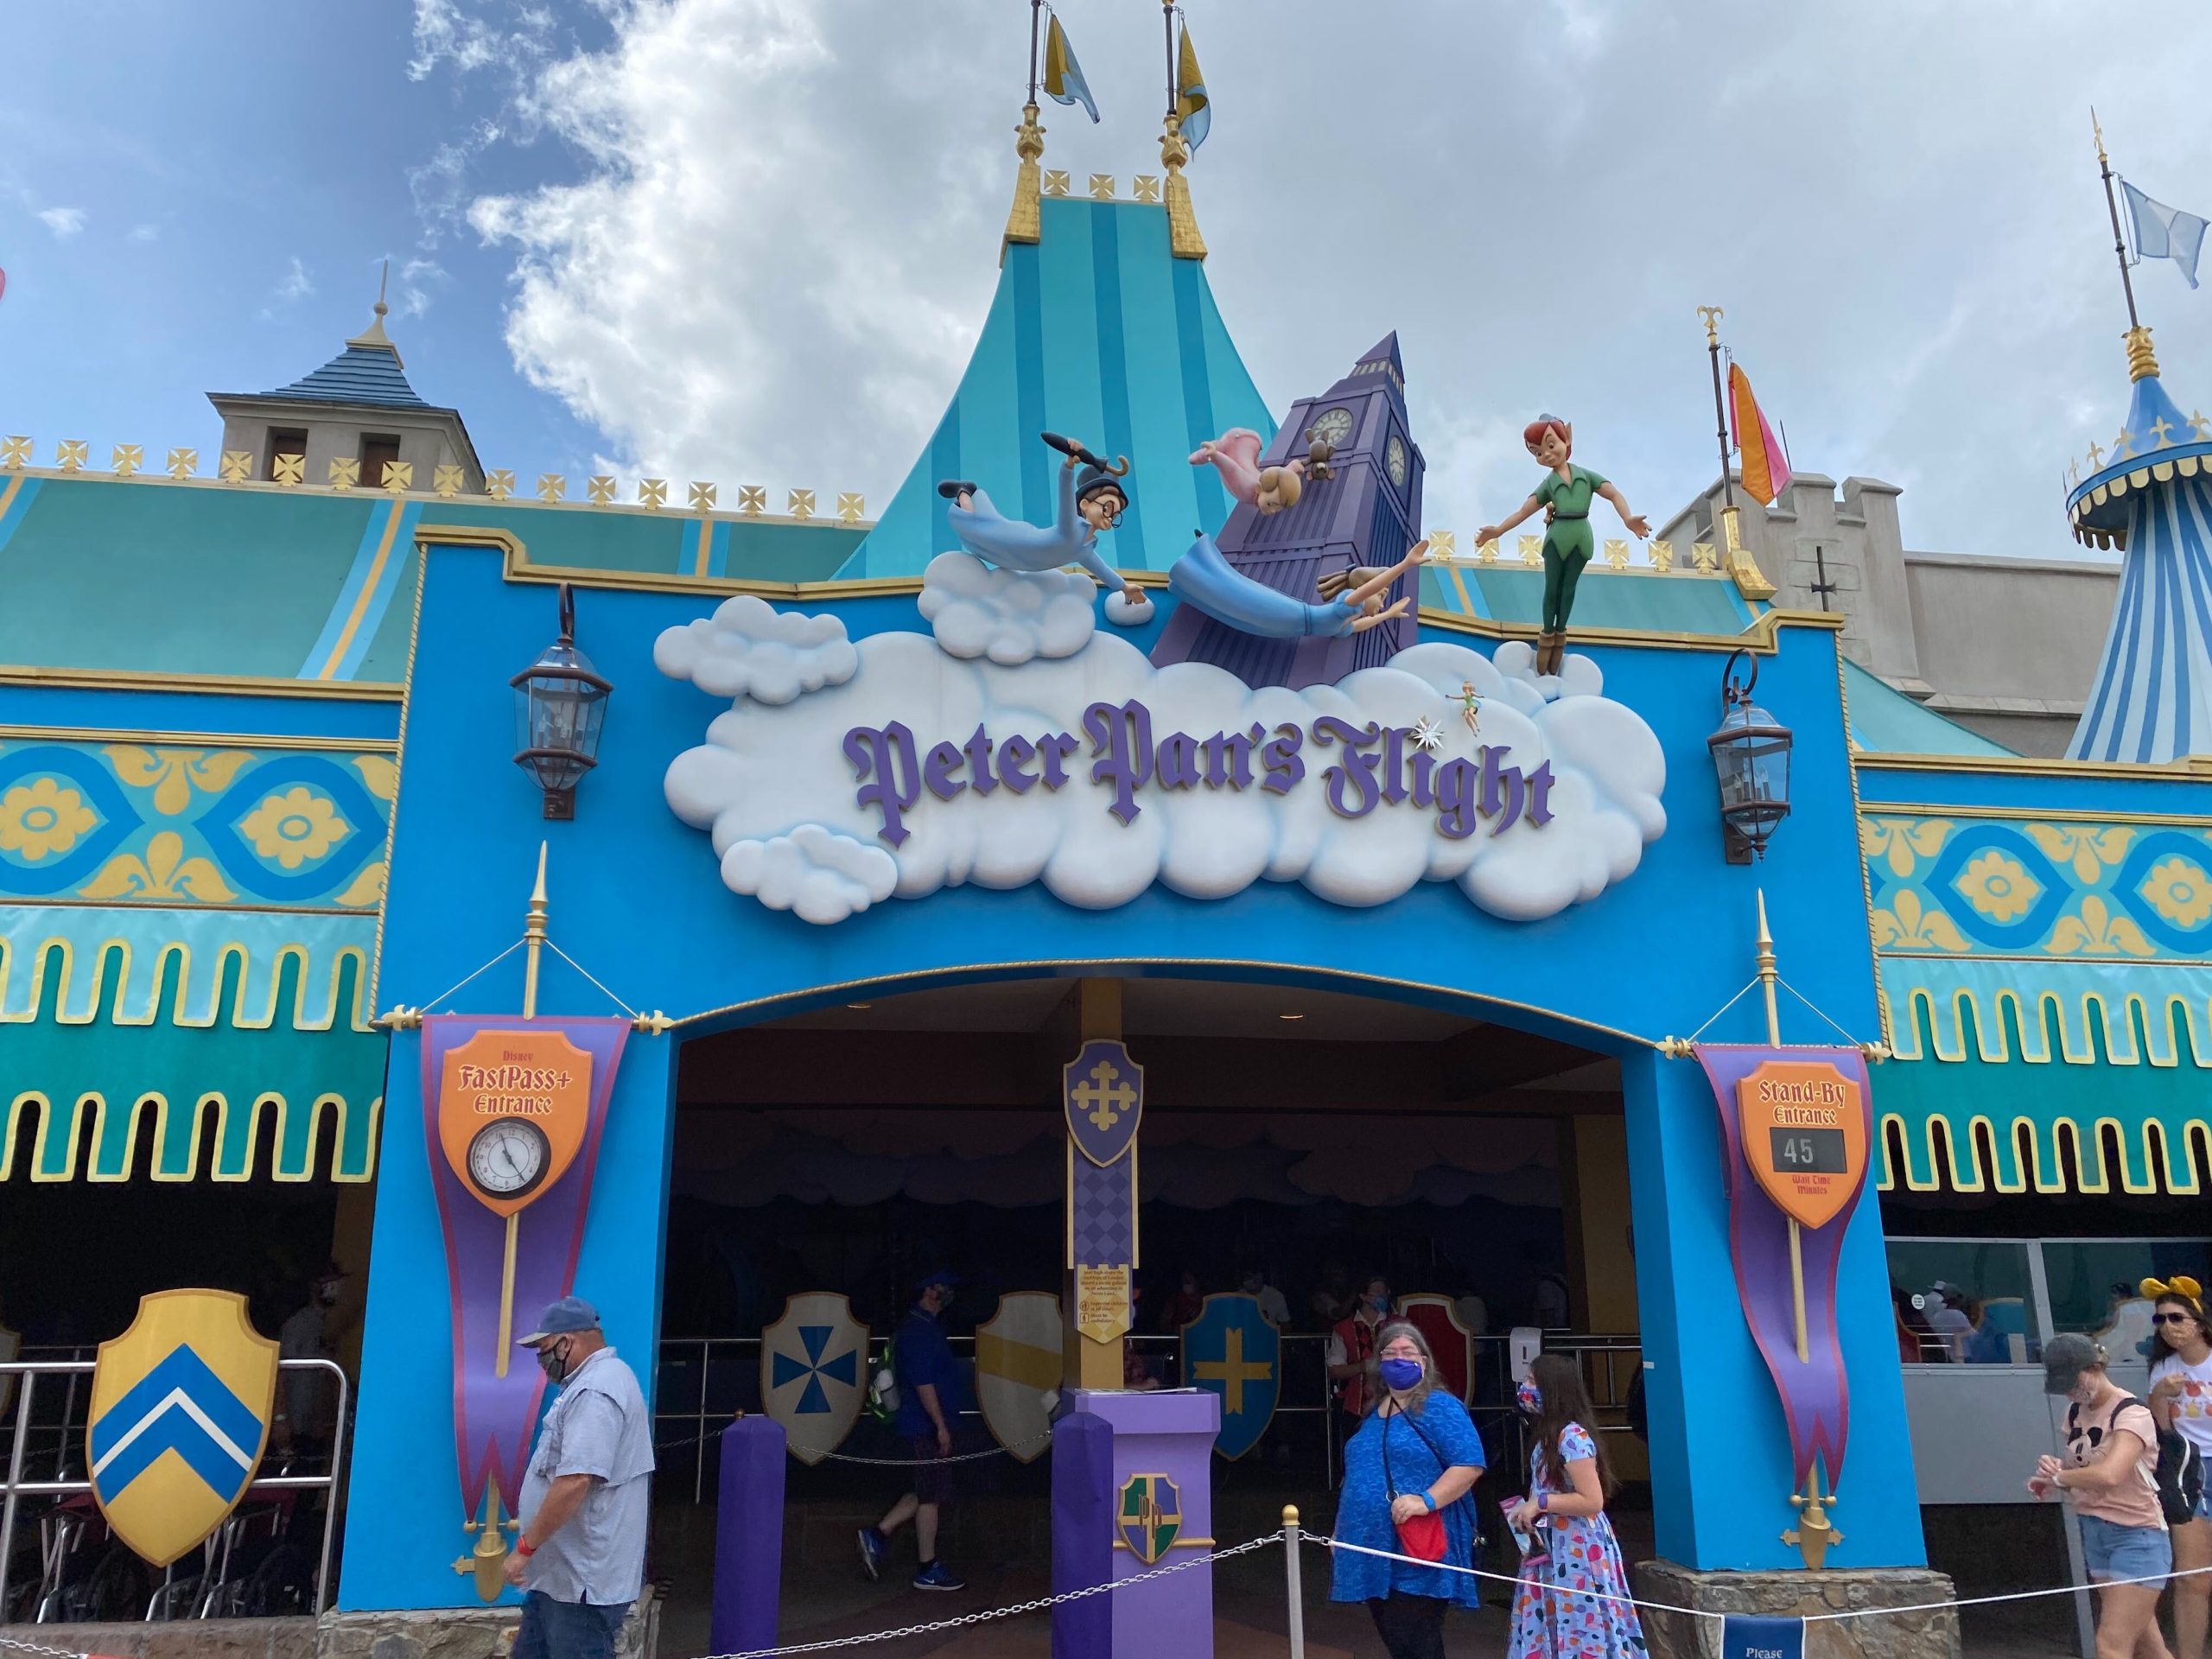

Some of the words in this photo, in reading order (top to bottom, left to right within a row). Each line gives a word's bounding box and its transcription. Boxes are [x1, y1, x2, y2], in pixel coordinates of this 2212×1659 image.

[842, 720, 1081, 850] Peter
[1082, 698, 1306, 827] Pan's
[1311, 715, 1556, 840] Flight
[502, 1050, 533, 1061] Disney
[458, 1064, 572, 1091] FastPass+
[1758, 1079, 1846, 1108] Stand-By
[474, 1094, 553, 1115] Entrance
[1773, 1105, 1838, 1125] Entrance
[1784, 1138, 1814, 1164] 45
[1792, 1174, 1810, 1185] Wait
[1812, 1175, 1831, 1185] Time
[1797, 1185, 1827, 1195] Minutes
[1745, 1647, 1783, 1659] Please
